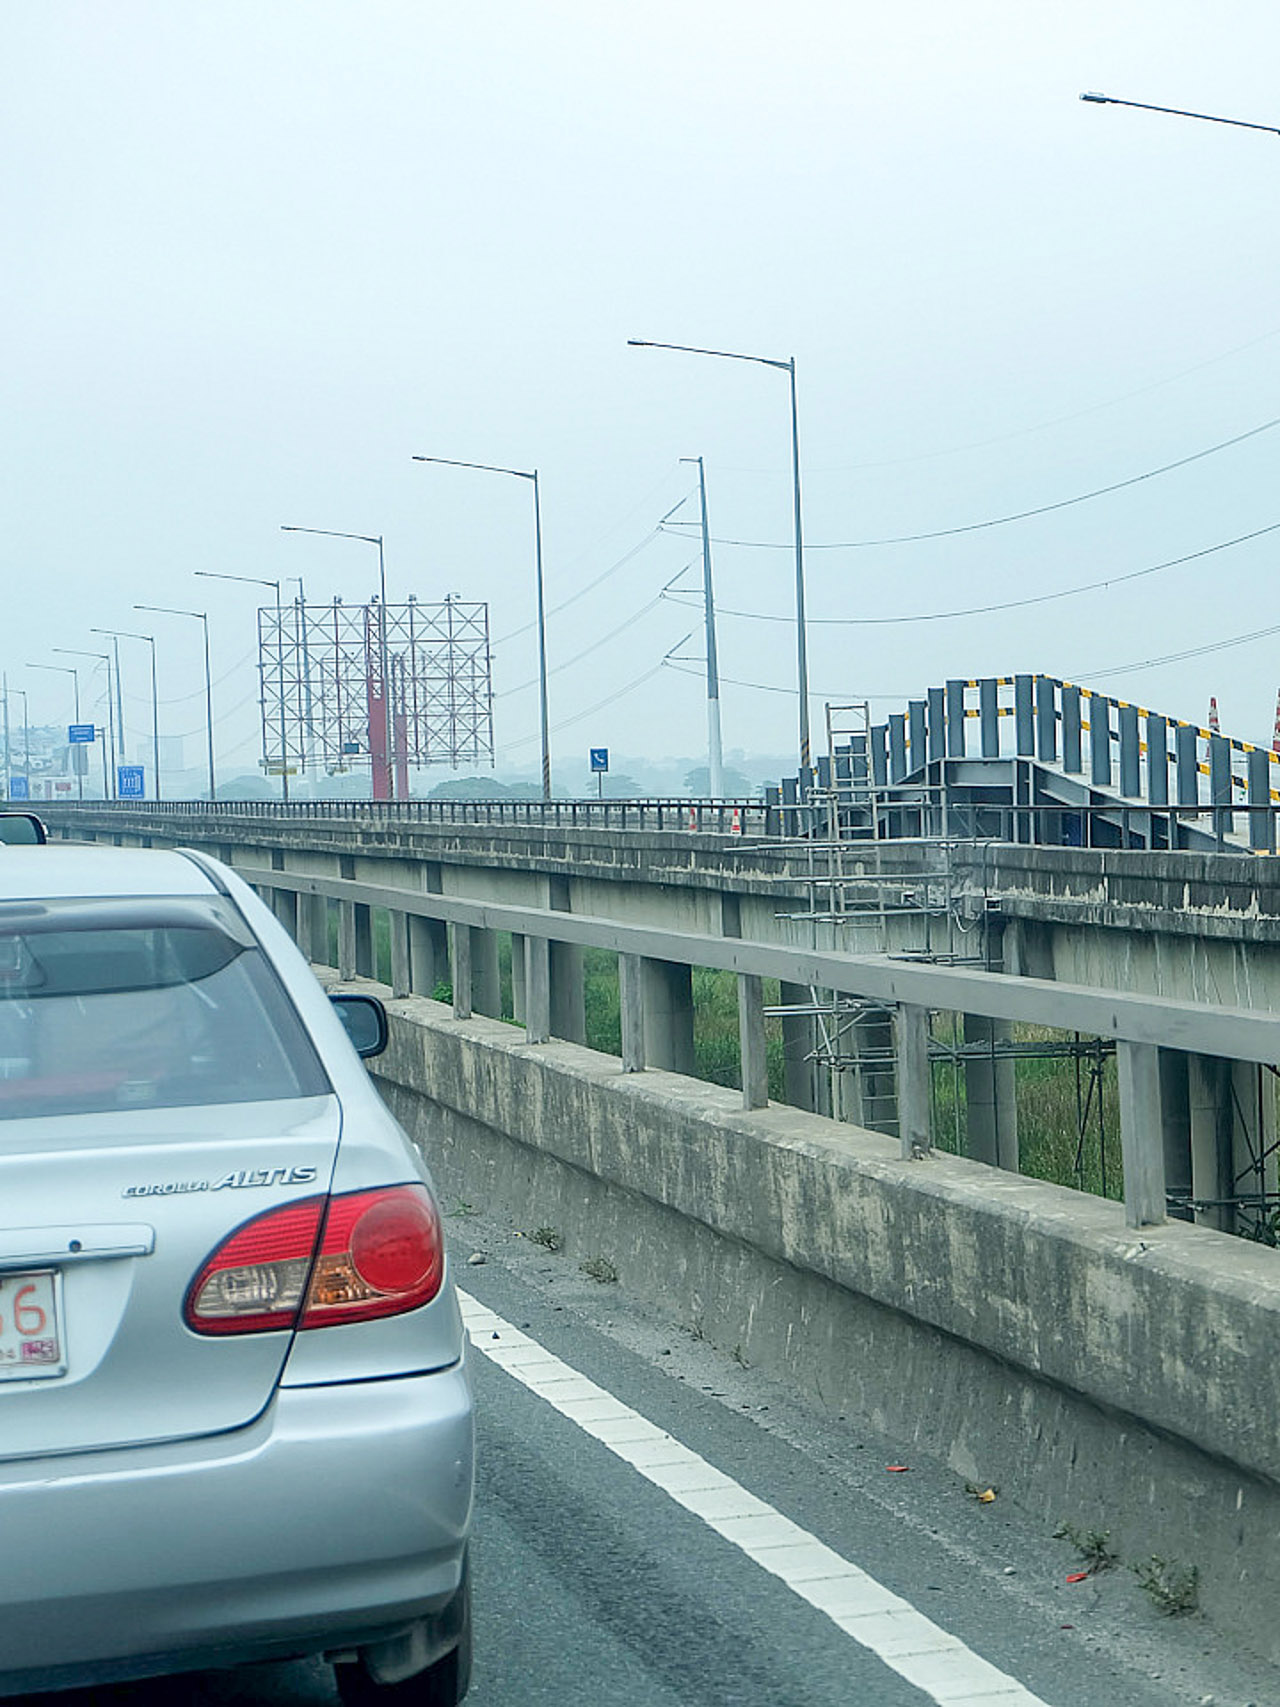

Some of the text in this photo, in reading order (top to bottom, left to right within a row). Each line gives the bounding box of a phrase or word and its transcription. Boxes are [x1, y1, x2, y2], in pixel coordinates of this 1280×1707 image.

[122, 1166, 316, 1198] COROLLA ALTIS
[0, 1284, 46, 1335] 6
